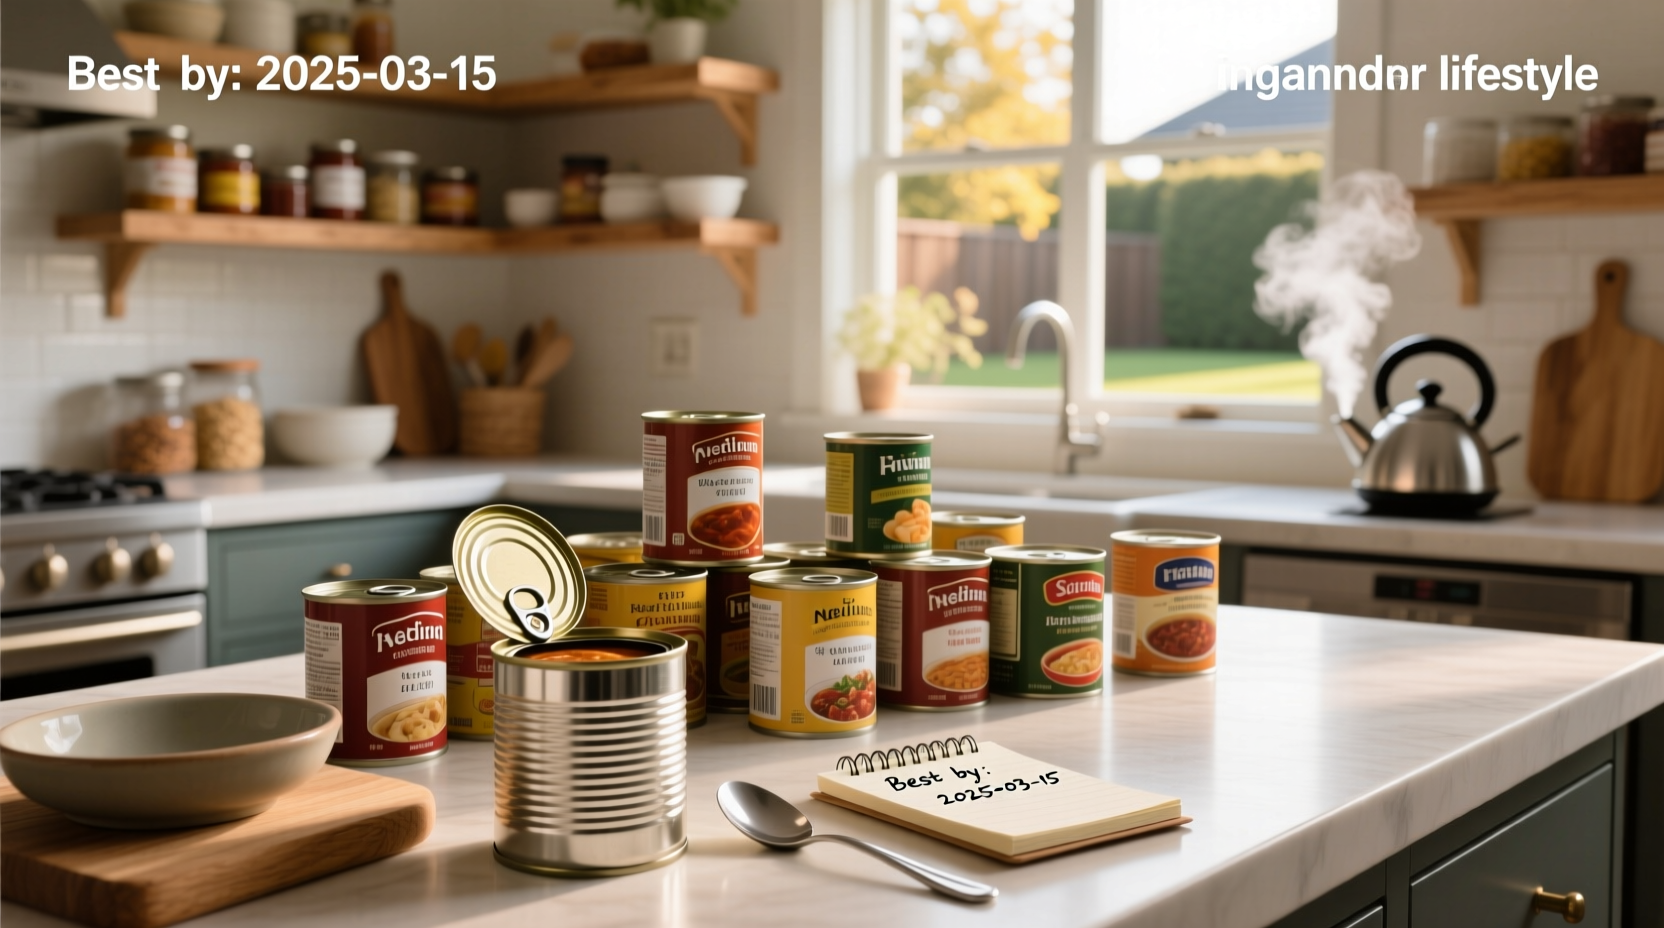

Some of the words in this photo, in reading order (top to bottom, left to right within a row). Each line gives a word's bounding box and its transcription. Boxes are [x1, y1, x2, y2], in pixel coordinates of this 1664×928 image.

[885, 771, 943, 791] Best
[950, 766, 991, 784] by:
[937, 771, 1060, 805] 2025-03-15
